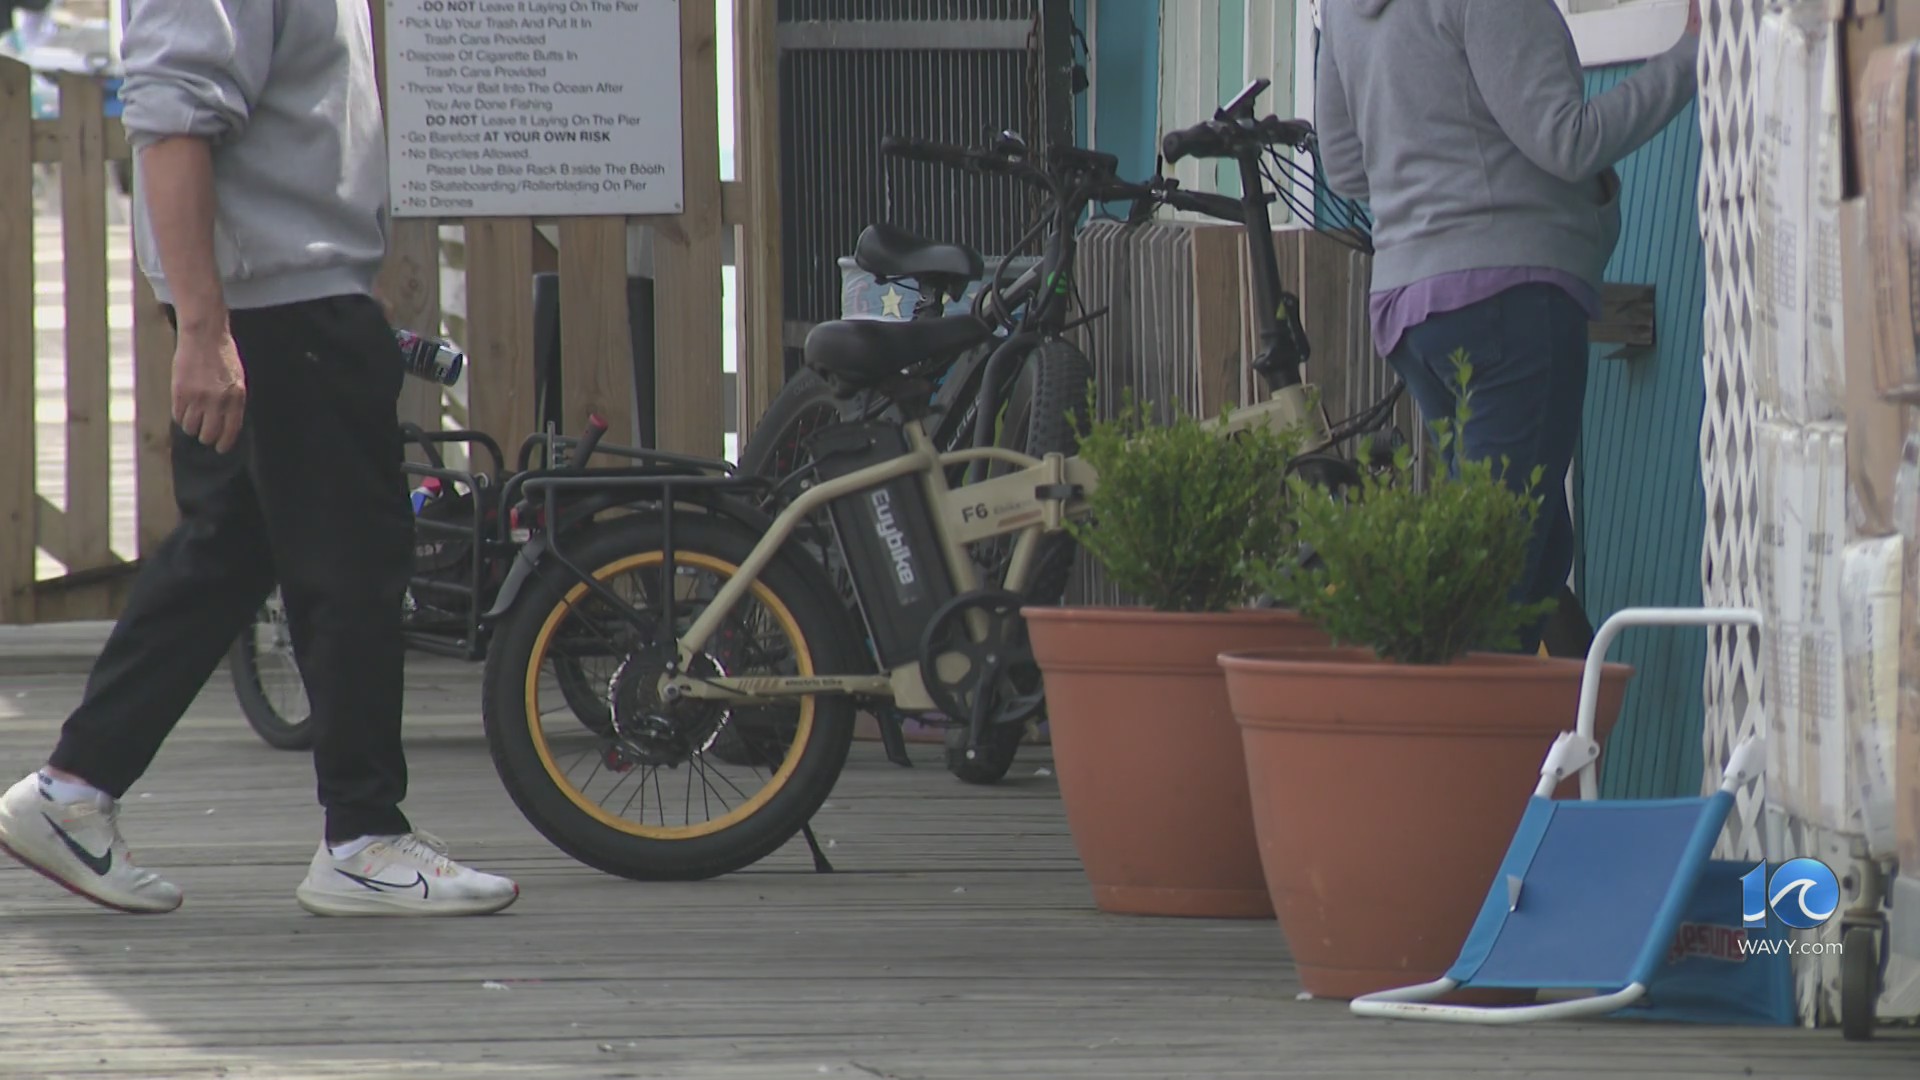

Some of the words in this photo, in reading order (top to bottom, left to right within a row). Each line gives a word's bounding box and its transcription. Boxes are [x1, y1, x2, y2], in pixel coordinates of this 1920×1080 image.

[424, 1, 444, 12] DO
[448, 1, 475, 12] NOT
[480, 1, 514, 12] Leave
[518, 1, 525, 12] It
[529, 1, 567, 14] Laying
[570, 1, 588, 12] On
[591, 1, 612, 12] The
[616, 1, 639, 12] Pier
[406, 17, 431, 28] Pick
[435, 17, 453, 30] Up
[456, 17, 482, 28] Your
[487, 17, 518, 28] Trash
[521, 17, 545, 28] And
[548, 17, 567, 28] Put
[570, 17, 578, 28] It
[581, 17, 593, 28] In
[425, 33, 456, 45] Trash
[460, 33, 490, 45] Cans
[494, 33, 546, 45] Provided
[406, 50, 455, 64] Dispose
[459, 50, 473, 62] Of
[476, 50, 530, 64] Cigarette
[533, 50, 564, 62] Butts
[567, 50, 578, 62] In
[425, 66, 457, 78] Trash
[460, 66, 491, 78] Cans
[495, 66, 546, 78] Provided
[408, 82, 444, 94] Throw
[447, 82, 473, 94] Your
[477, 82, 500, 94] Bait
[503, 82, 526, 94] Into
[528, 82, 550, 94] The
[553, 82, 593, 94] Ocean
[596, 82, 623, 94] After
[425, 99, 448, 110] You
[451, 99, 471, 110] Are
[475, 99, 507, 110] Done
[510, 99, 553, 112] Fishing
[426, 114, 446, 126] DO
[450, 114, 478, 126] NOT
[482, 114, 516, 126] Leave
[520, 114, 527, 126] It
[531, 114, 568, 128] Laying
[572, 114, 590, 126] On
[593, 114, 614, 126] The
[618, 114, 641, 126] Pier
[408, 131, 426, 142] Go
[430, 131, 480, 142] Barefoot
[484, 131, 499, 142] AT
[504, 131, 540, 142] YOUR
[544, 131, 576, 142] OWN
[580, 131, 611, 142] RISK
[408, 148, 426, 159] No
[430, 148, 480, 161] Bicycles
[483, 148, 528, 159] Allowed
[426, 163, 466, 175] Please
[470, 163, 493, 175] Use
[498, 163, 523, 175] Bike
[527, 163, 557, 175] Rack
[605, 162, 626, 175] The
[630, 163, 665, 175] Booth
[408, 180, 427, 192] No
[430, 180, 599, 194] Skateboarding/Rollerblading
[602, 179, 620, 192] On
[624, 179, 647, 192] Pier
[409, 196, 427, 208] No
[430, 196, 473, 208] Drones
[961, 502, 988, 523] F6
[871, 488, 915, 585] Euybike
[822, 678, 844, 687] bike
